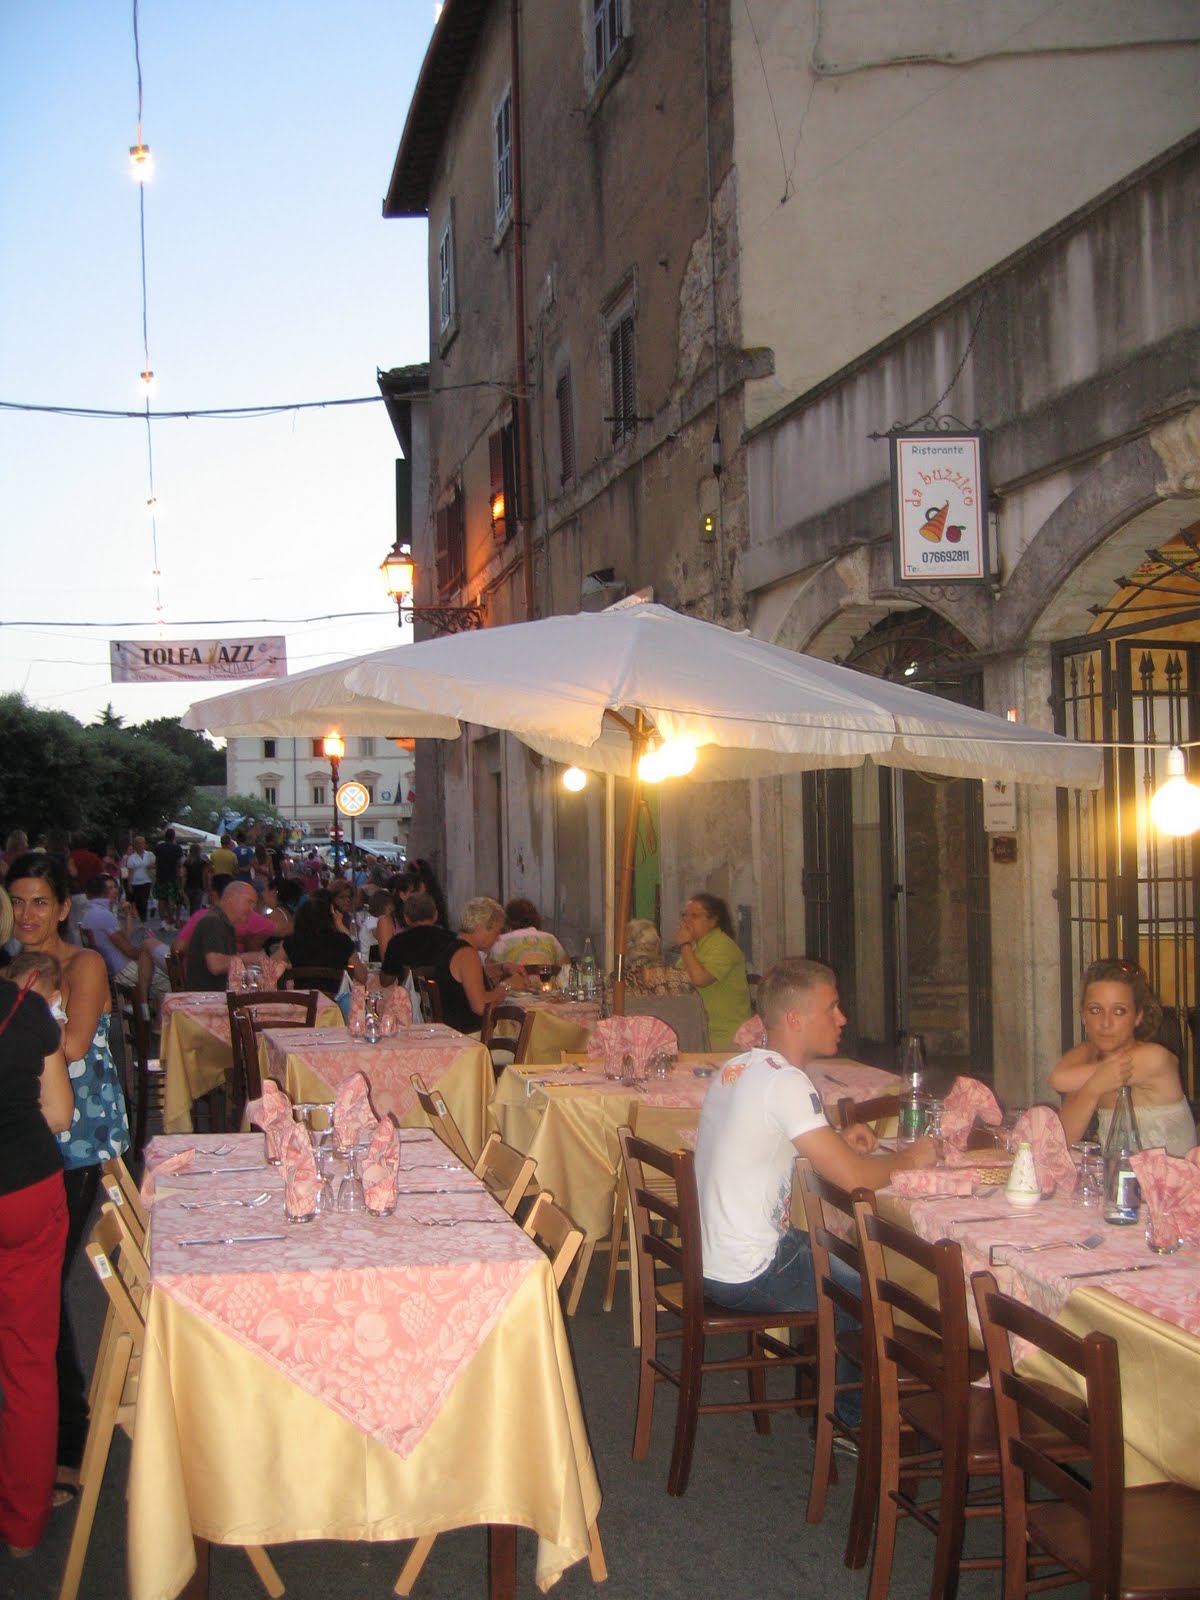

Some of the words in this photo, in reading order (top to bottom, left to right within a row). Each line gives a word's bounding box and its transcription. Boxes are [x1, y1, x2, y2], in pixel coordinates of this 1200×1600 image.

[911, 445, 964, 455] Ristorante
[905, 488, 923, 507] da
[918, 468, 974, 506] buzzico
[922, 550, 970, 563] 076692811
[141, 647, 203, 665] TOLFA
